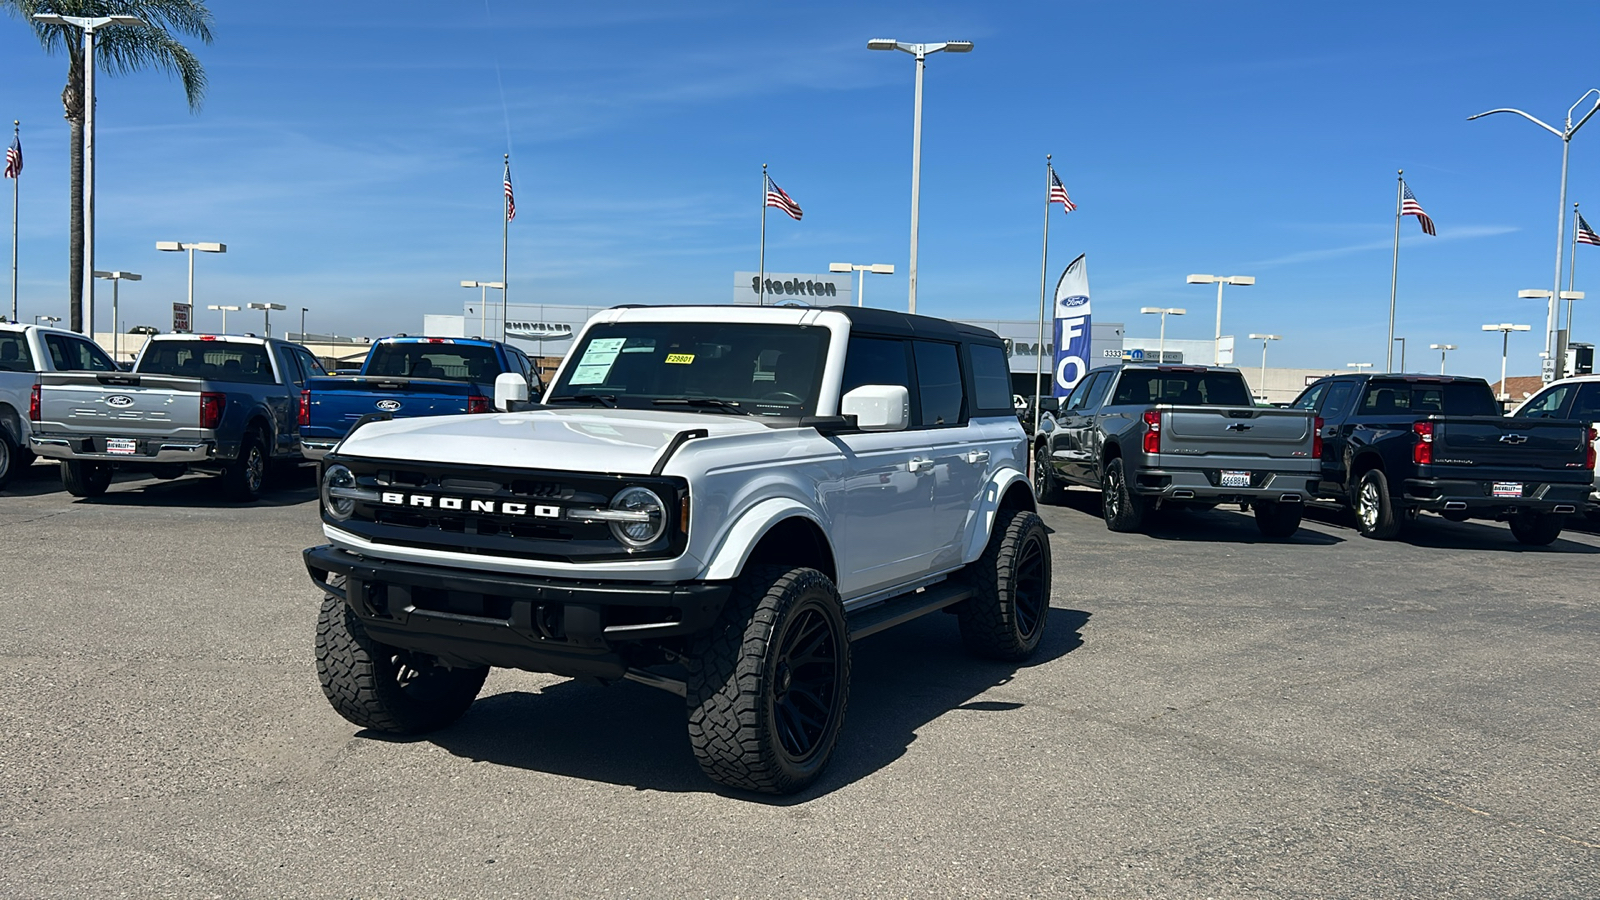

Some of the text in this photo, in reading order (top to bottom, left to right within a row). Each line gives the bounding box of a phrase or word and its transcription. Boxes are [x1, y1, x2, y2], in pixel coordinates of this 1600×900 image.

[752, 276, 836, 297] Stockton
[1065, 296, 1085, 307] Ford
[173, 320, 188, 330] CARS
[505, 322, 571, 332] CHRYSLER
[382, 492, 560, 518] BRONCO
